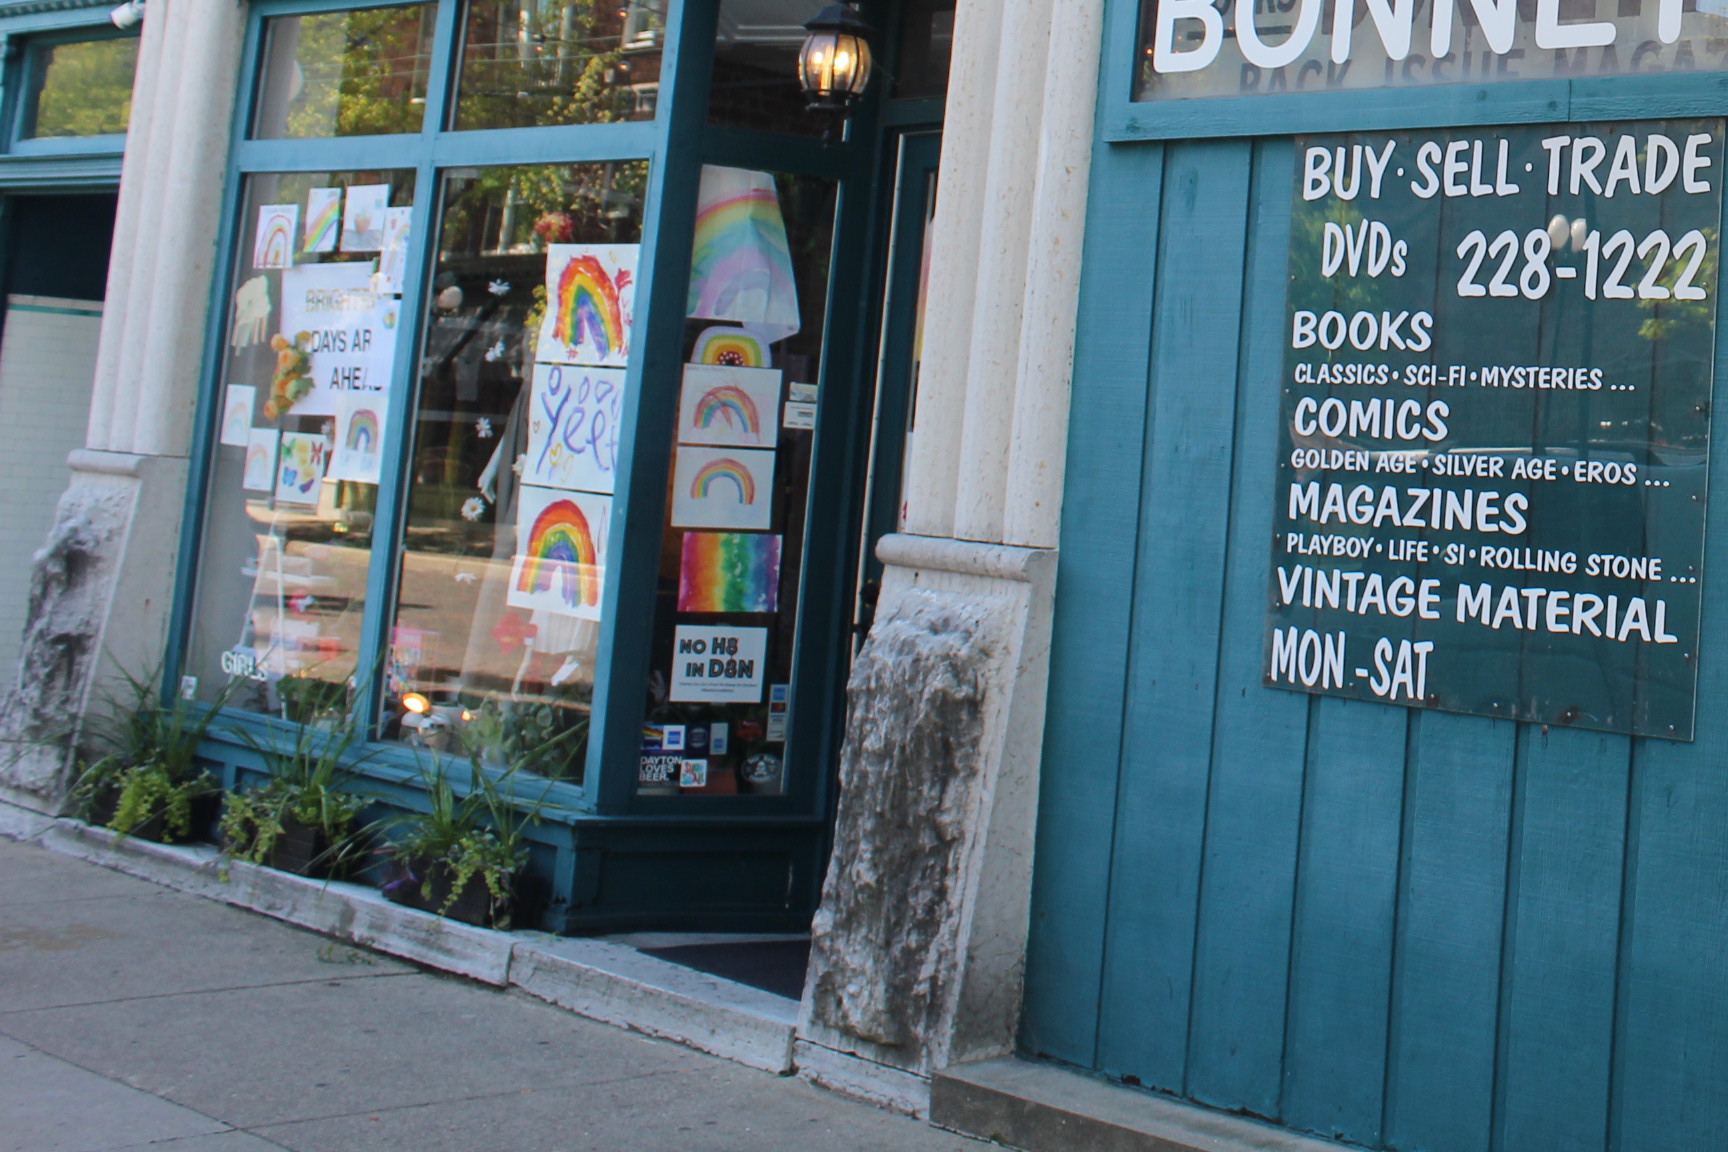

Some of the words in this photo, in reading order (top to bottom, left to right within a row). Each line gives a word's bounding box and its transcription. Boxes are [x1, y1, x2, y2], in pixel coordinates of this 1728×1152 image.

[1302, 139, 1397, 202] BUY
[1410, 138, 1520, 200] SELL
[1542, 133, 1712, 199] TRADE
[1321, 218, 1408, 279] DVDs
[1456, 227, 1708, 301] 228-1222
[1292, 310, 1434, 352] BOOKS
[1294, 363, 1389, 386] CLASSICS
[1403, 366, 1467, 388] SCI-FI
[1480, 366, 1603, 391] MYSTERIES
[1294, 397, 1450, 442] COMICS
[1291, 450, 1370, 473] GOLDEN
[1375, 451, 1417, 475] AGE
[1432, 455, 1504, 479] SILVER
[1511, 459, 1556, 481] AGE
[1574, 461, 1638, 486] EROS
[1288, 482, 1528, 535] MAGAZINES
[1287, 533, 1374, 559] PLAYBOY
[1388, 541, 1428, 563] LIFE
[1445, 543, 1466, 565] SI
[1480, 548, 1578, 574] ROLLING
[1585, 555, 1662, 581] STONE
[1277, 566, 1441, 619] VINTAGE
[1456, 583, 1678, 644] MATERIAL
[679, 639, 707, 655] NO
[1270, 628, 1346, 689] MON
[686, 662, 705, 678] IN
[639, 764, 675, 774] LOVES
[640, 756, 682, 766] DAYTON
